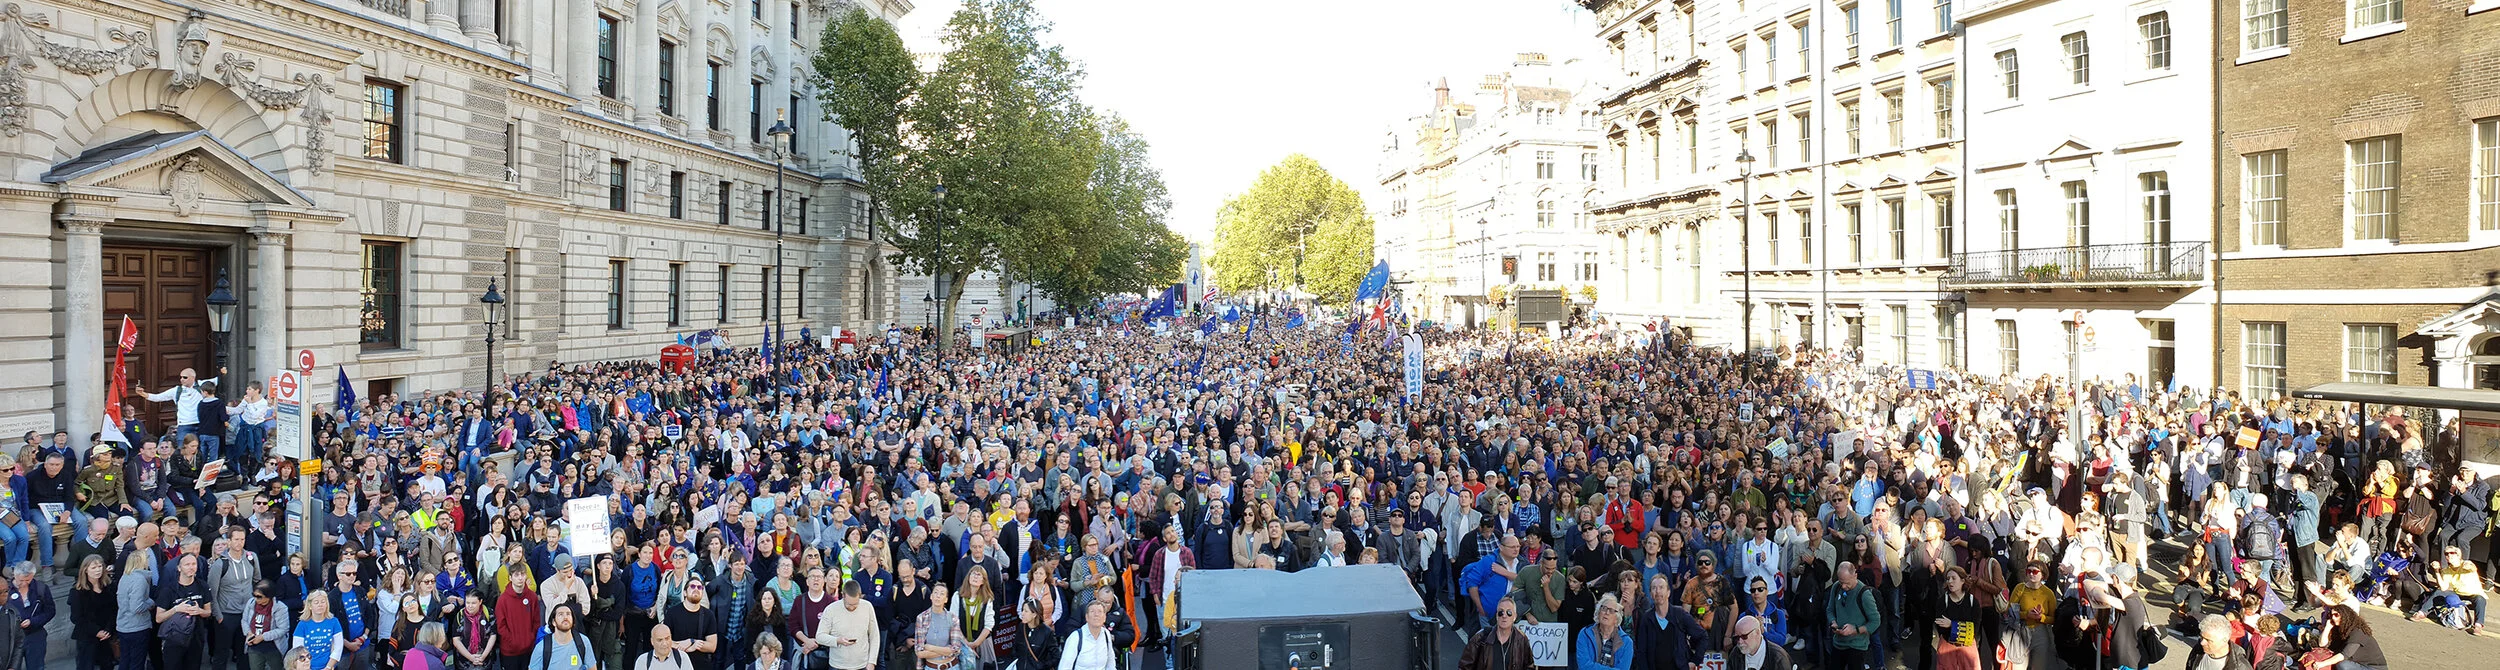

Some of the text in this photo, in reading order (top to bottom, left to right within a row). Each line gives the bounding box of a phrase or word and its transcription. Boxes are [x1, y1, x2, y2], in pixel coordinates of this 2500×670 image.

[300, 353, 310, 368] C
[996, 625, 1017, 636] EUROPE
[1519, 624, 1567, 638] EMOCRACY
[994, 634, 1016, 644] ORTRESS
[1001, 642, 1013, 650] END
[1532, 640, 1562, 660] OW
